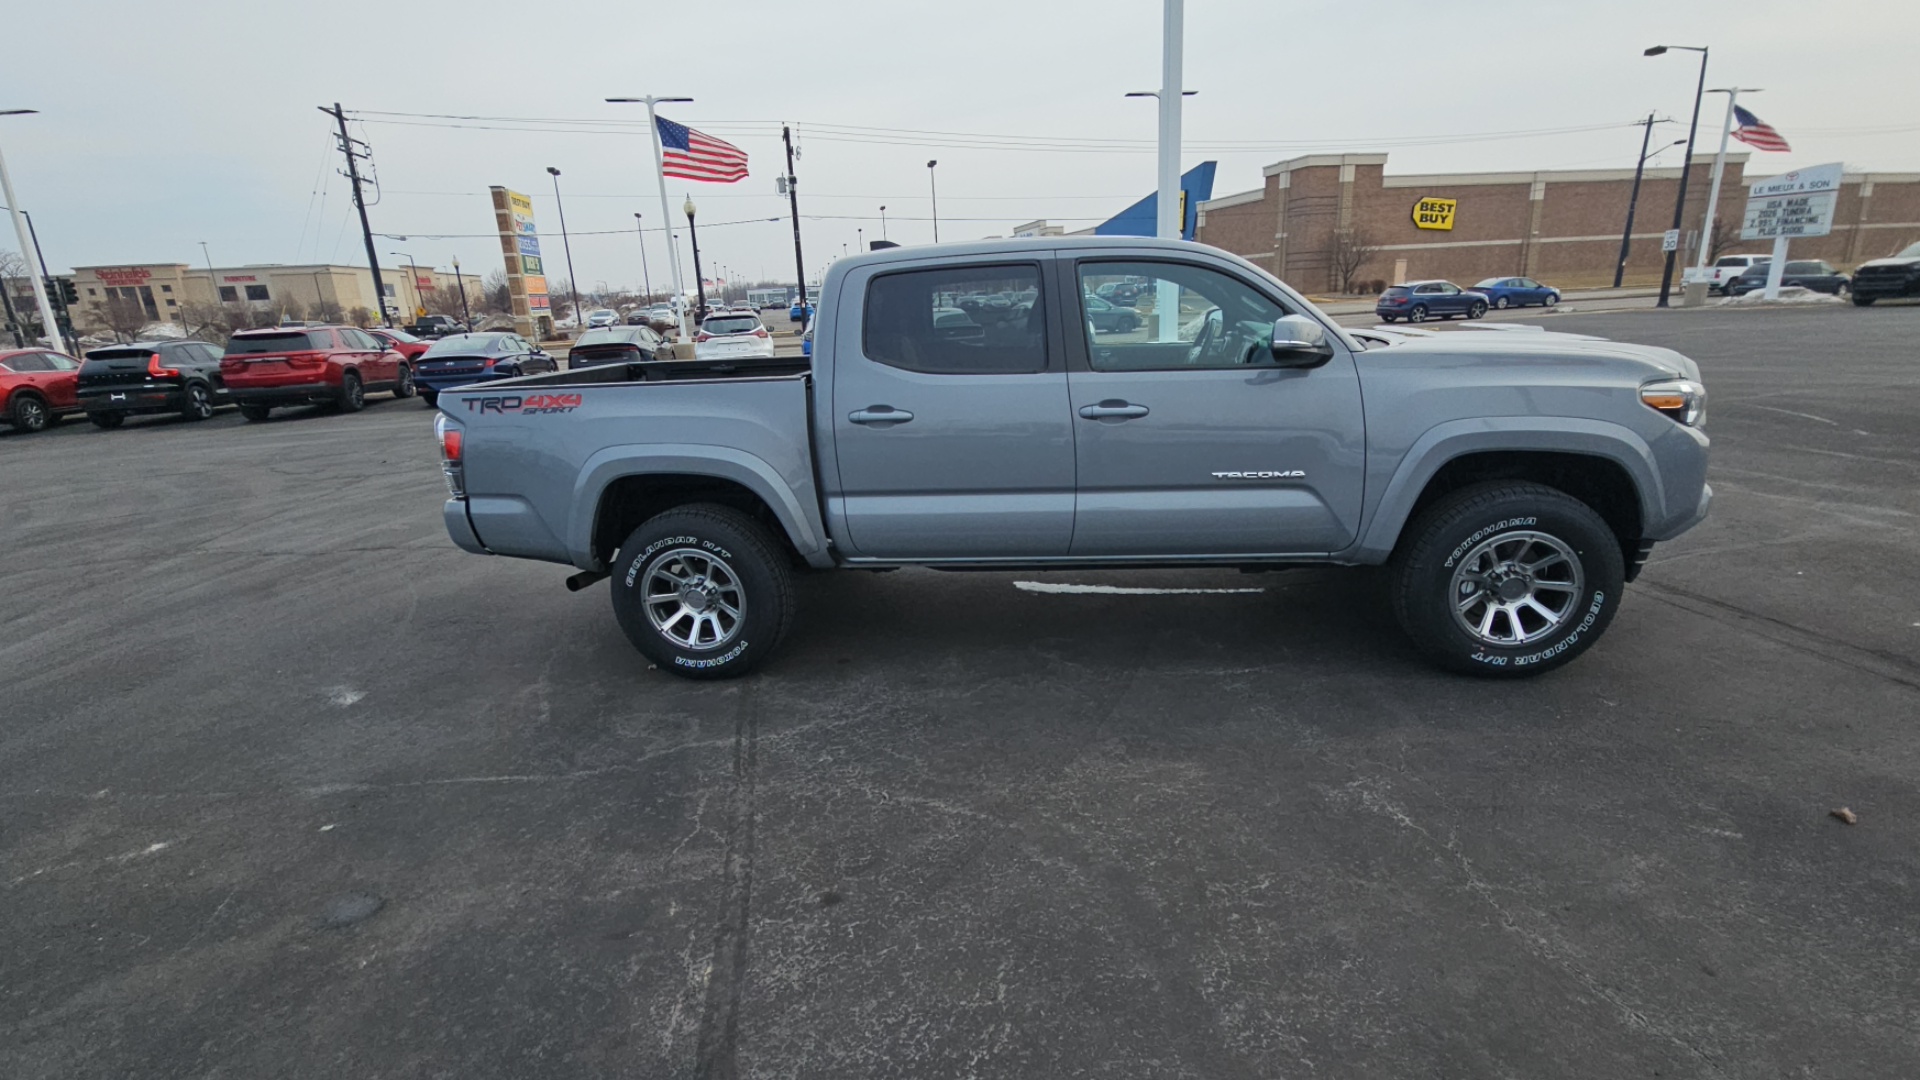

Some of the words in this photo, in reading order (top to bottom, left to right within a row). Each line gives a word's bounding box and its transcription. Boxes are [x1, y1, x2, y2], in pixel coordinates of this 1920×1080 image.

[1754, 186, 1765, 195] LE
[1768, 184, 1795, 192] MIEUX
[1799, 182, 1804, 190] &
[1809, 180, 1830, 189] SON
[1420, 202, 1454, 213] BEST
[1782, 207, 1812, 216] TUNDRA
[1419, 213, 1449, 224] BUY
[1776, 215, 1819, 225] FINANCING
[1758, 227, 1777, 236] PLUS
[1664, 240, 1676, 249] 30
[461, 396, 523, 414] TRD
[522, 406, 578, 415] SPORT
[1211, 470, 1306, 479] TACOMA
[1444, 517, 1537, 568] YOKOHAMA
[626, 536, 698, 587] GEOLANDAR
[1515, 591, 1605, 665] GEOLANDAR
[675, 640, 749, 668] YOKOHAMA
